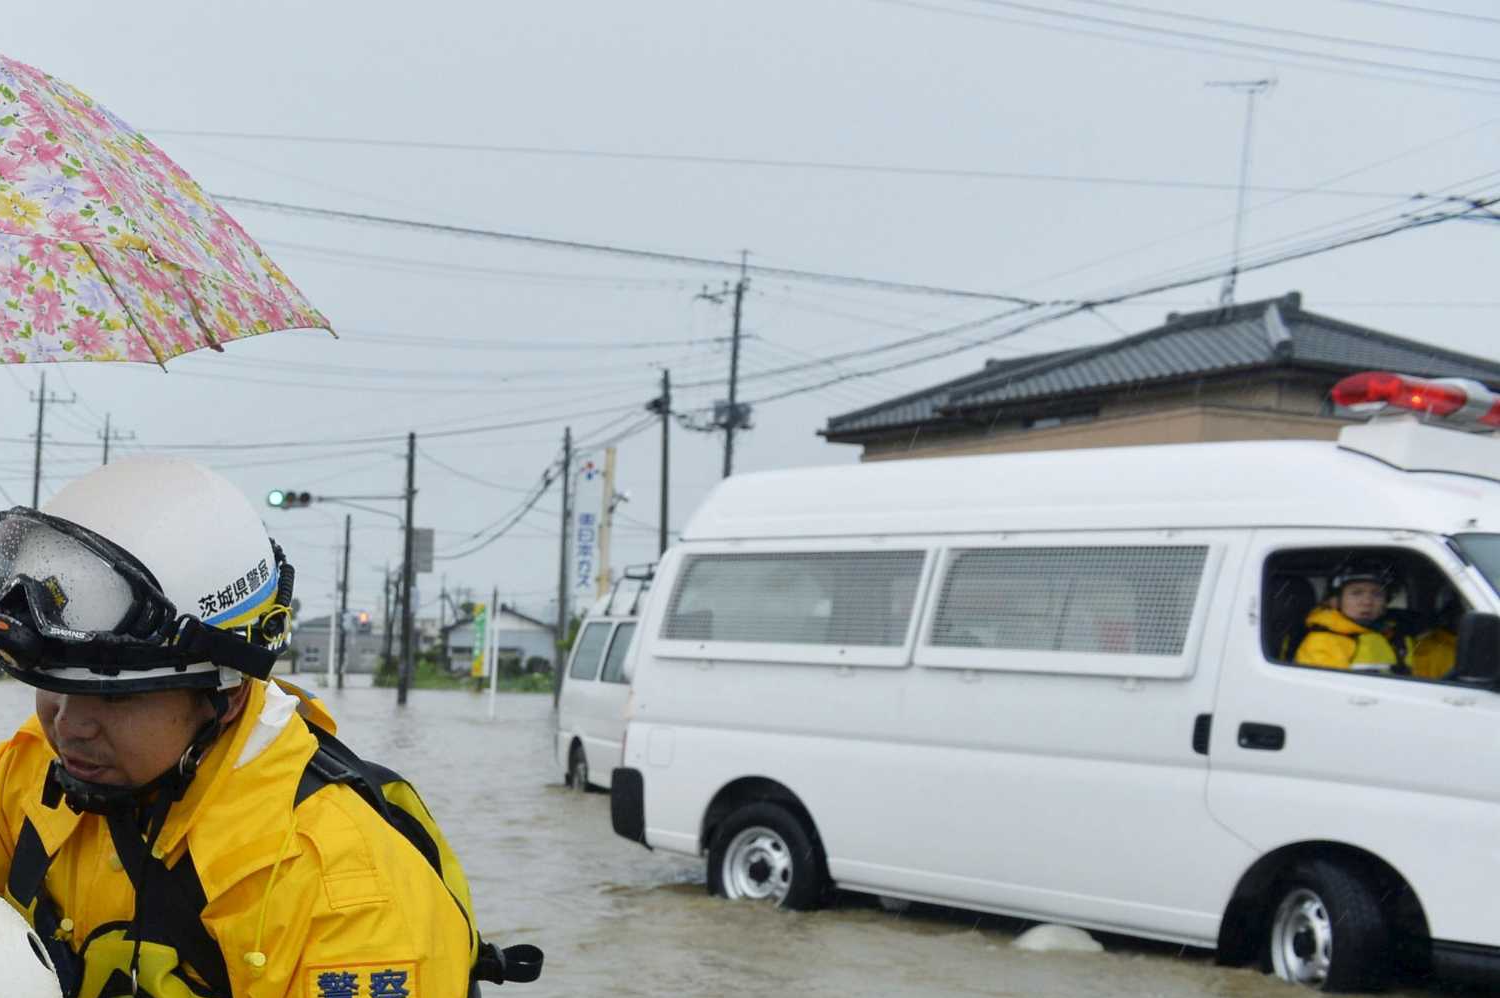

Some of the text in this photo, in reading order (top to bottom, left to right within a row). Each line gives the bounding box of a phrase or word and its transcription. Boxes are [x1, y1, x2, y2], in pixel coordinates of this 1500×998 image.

[198, 559, 269, 617] 茨城県警察
[50, 626, 87, 639] SWANS
